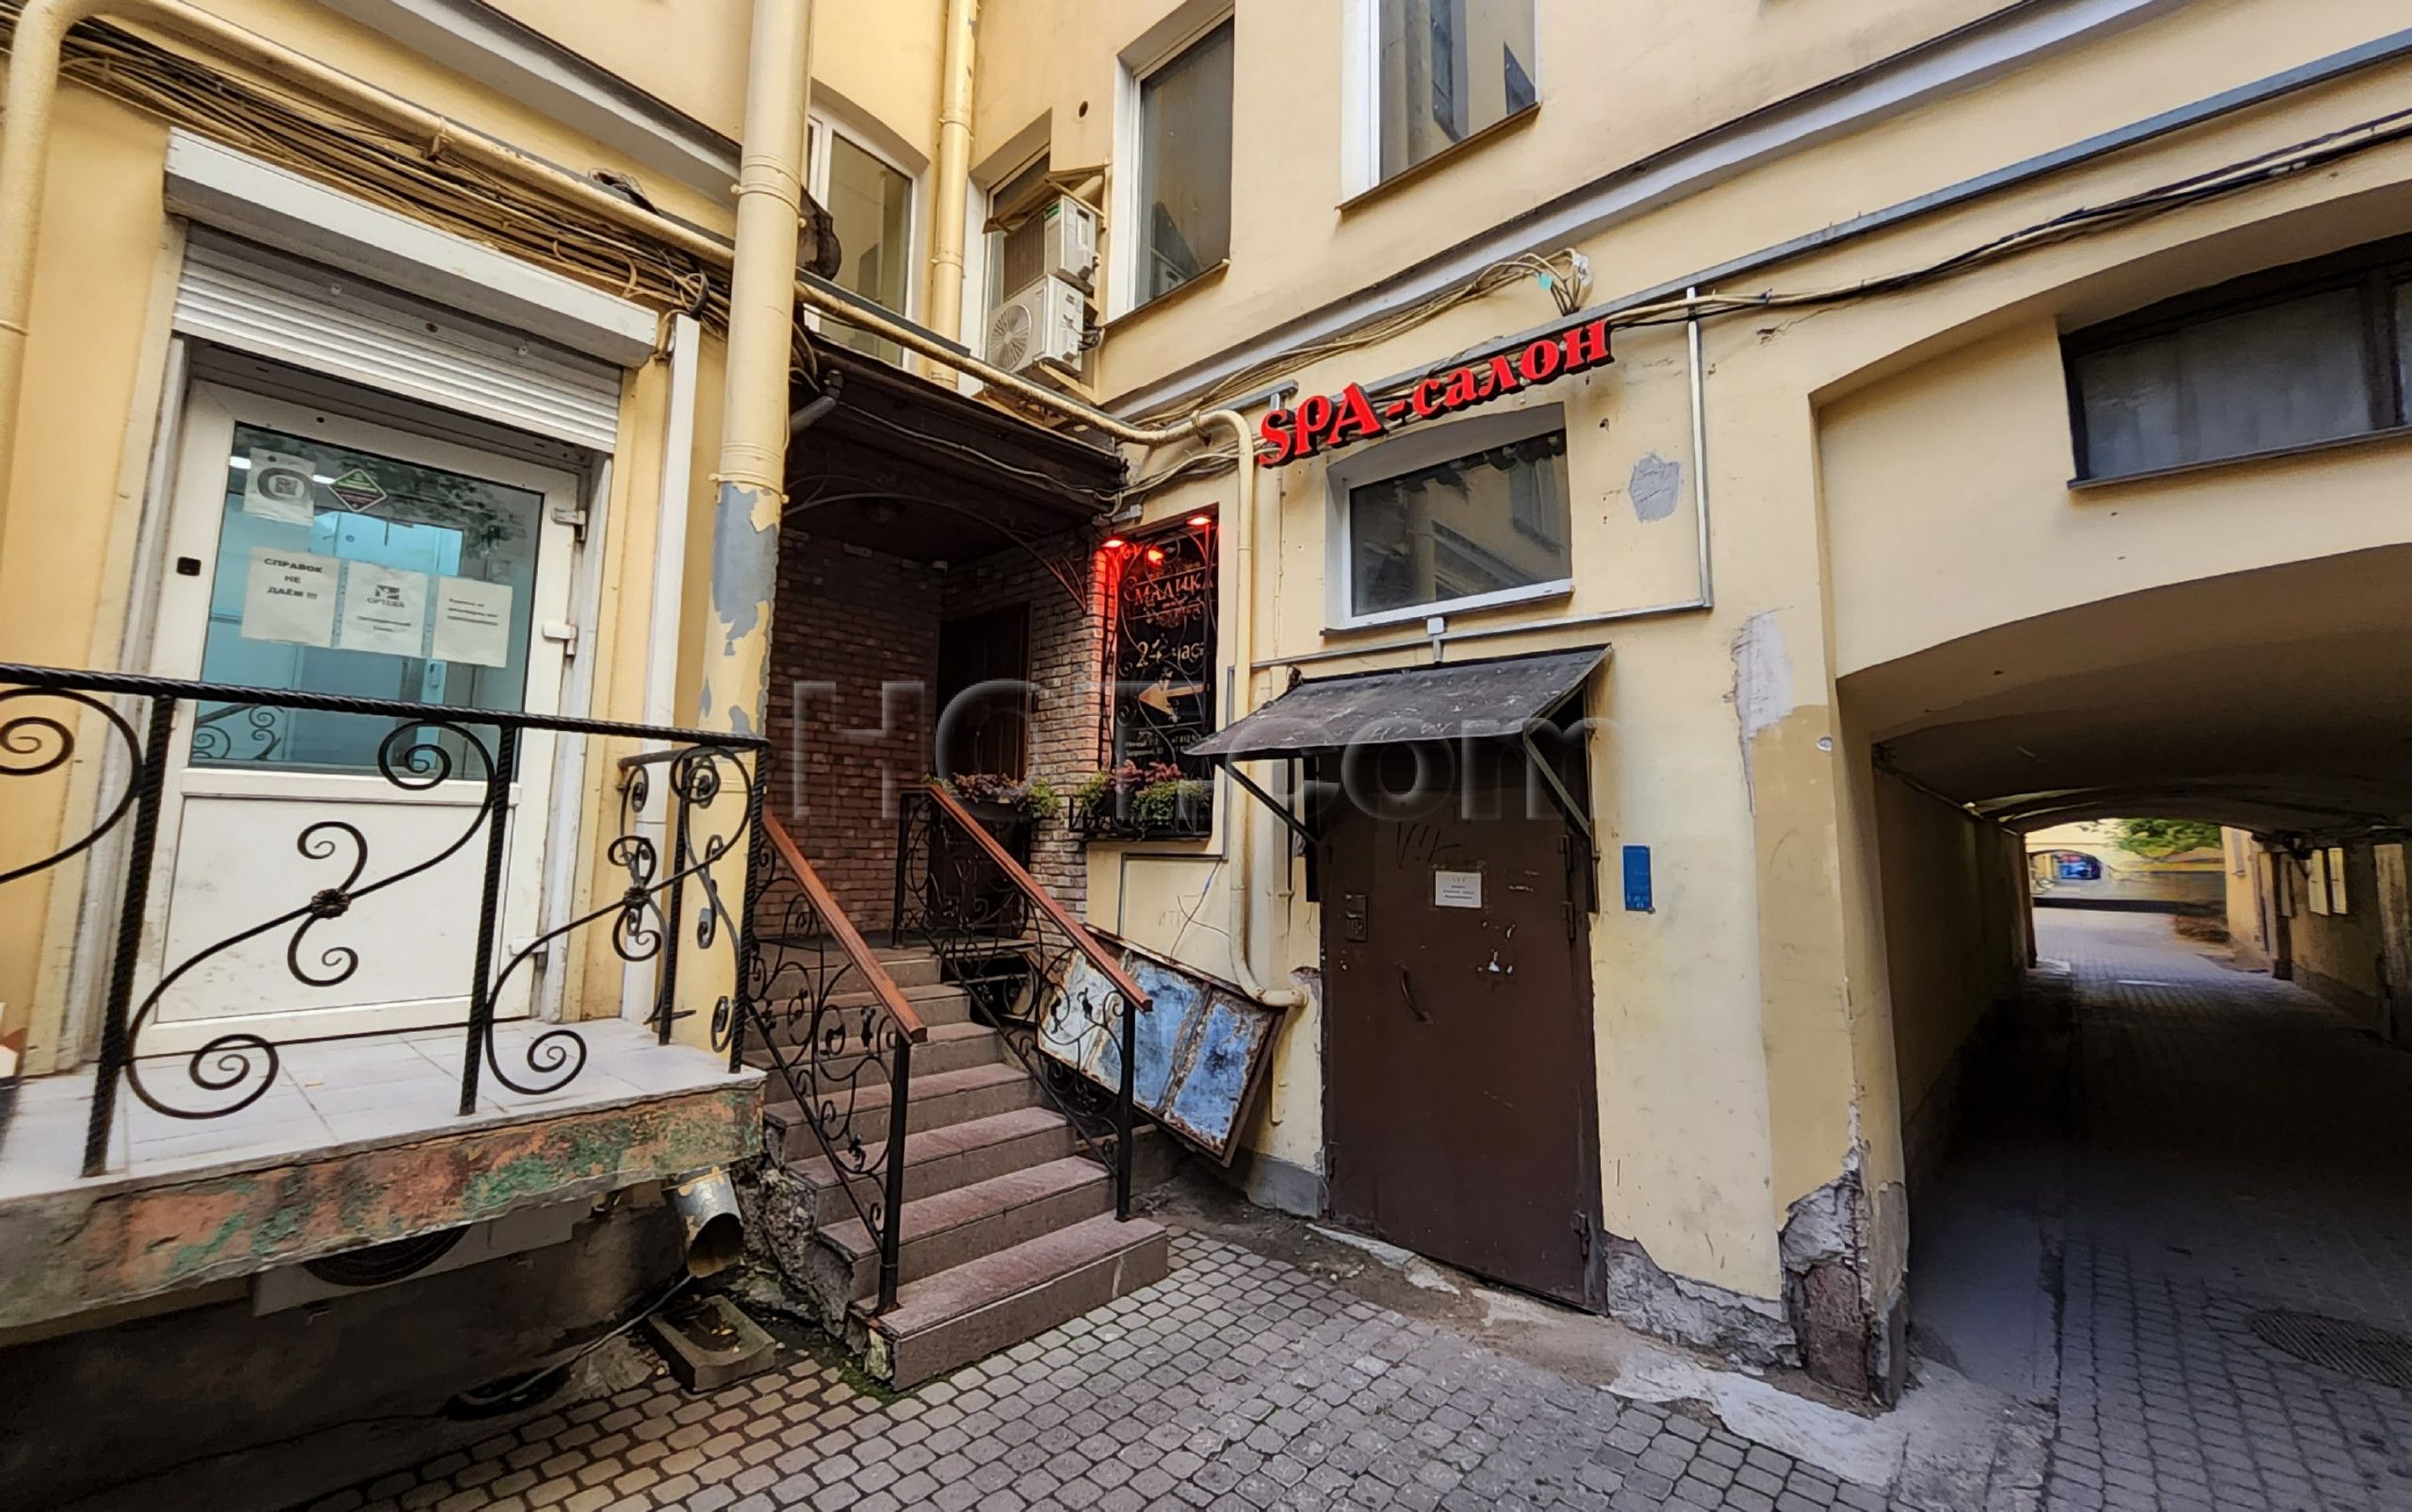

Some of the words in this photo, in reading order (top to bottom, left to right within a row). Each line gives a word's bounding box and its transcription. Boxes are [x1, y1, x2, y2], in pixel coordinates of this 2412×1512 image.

[1259, 318, 1612, 466] SPA-салон
[264, 558, 323, 573] СПРАВОК
[285, 575, 302, 583] НЕ
